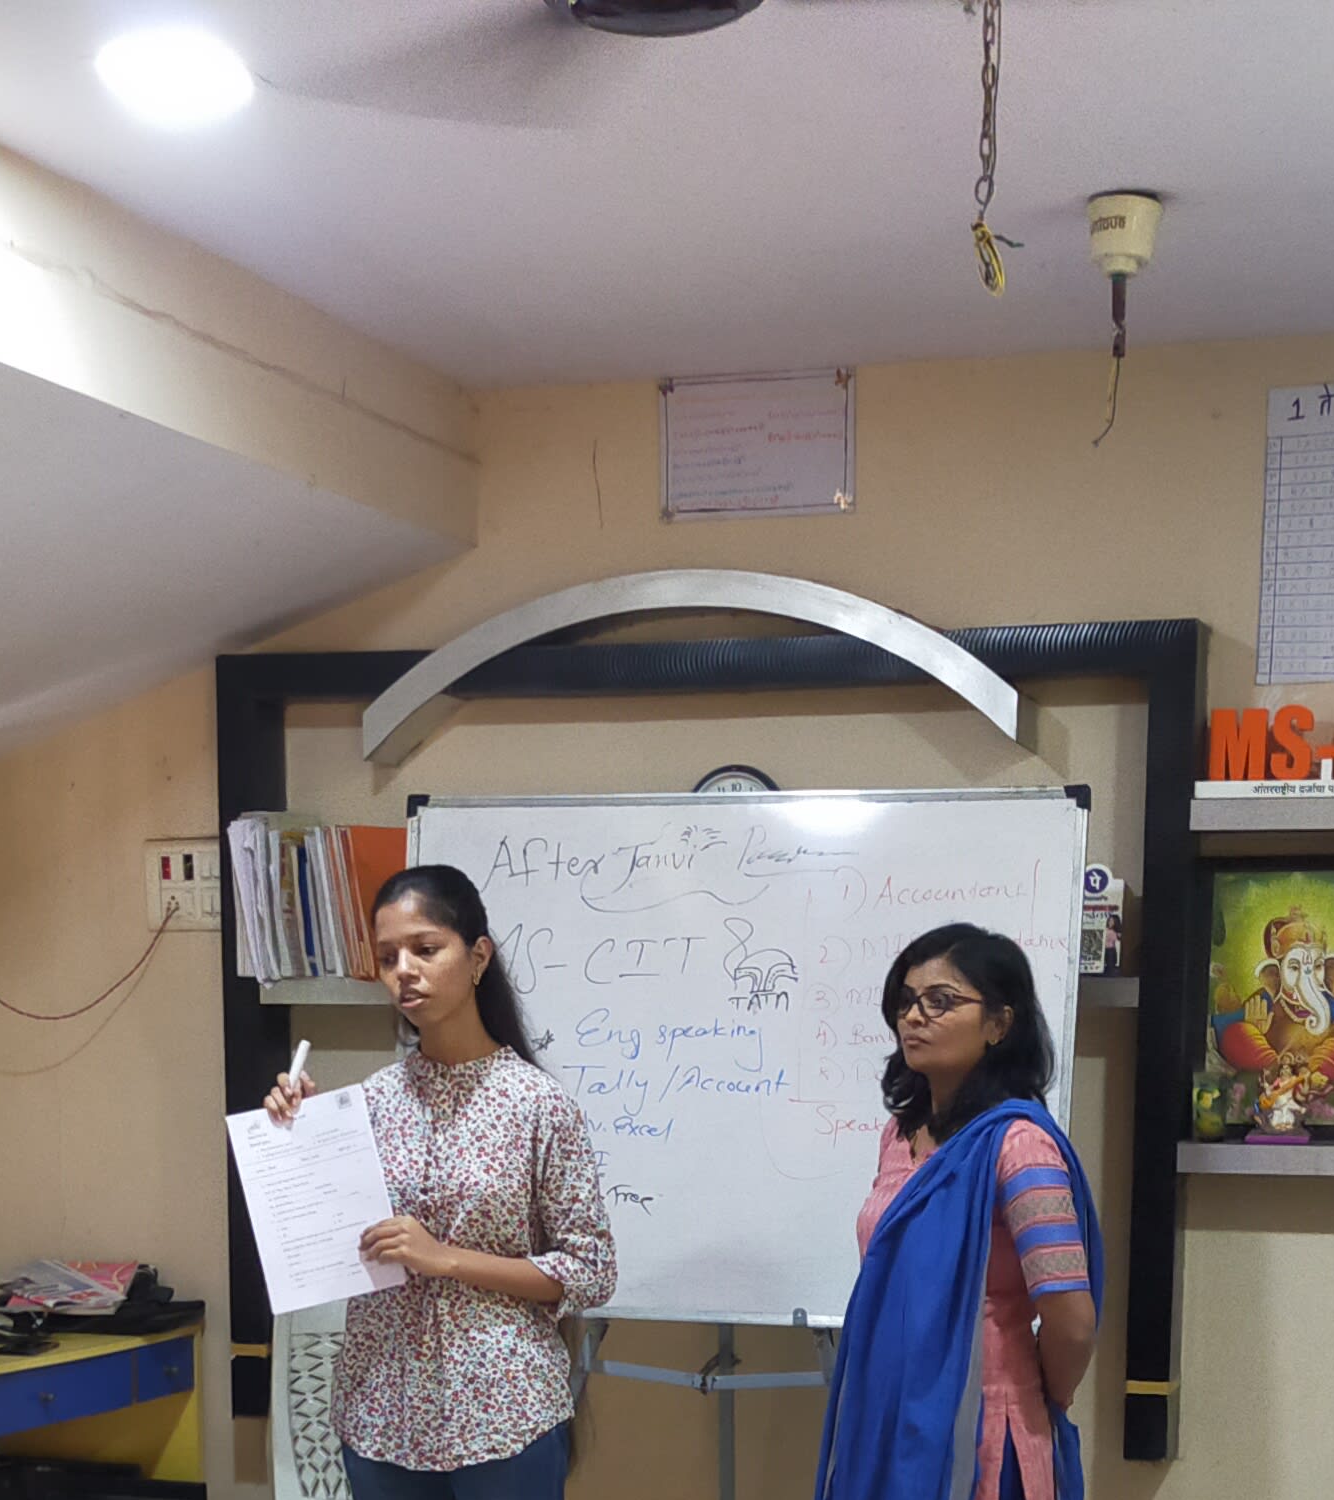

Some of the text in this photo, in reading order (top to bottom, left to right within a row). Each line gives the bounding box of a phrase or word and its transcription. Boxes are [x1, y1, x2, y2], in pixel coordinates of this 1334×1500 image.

[1287, 397, 1305, 421] 1
[481, 835, 605, 893] After
[576, 1008, 764, 1071] Eng speaking
[563, 1065, 649, 1116] Tally
